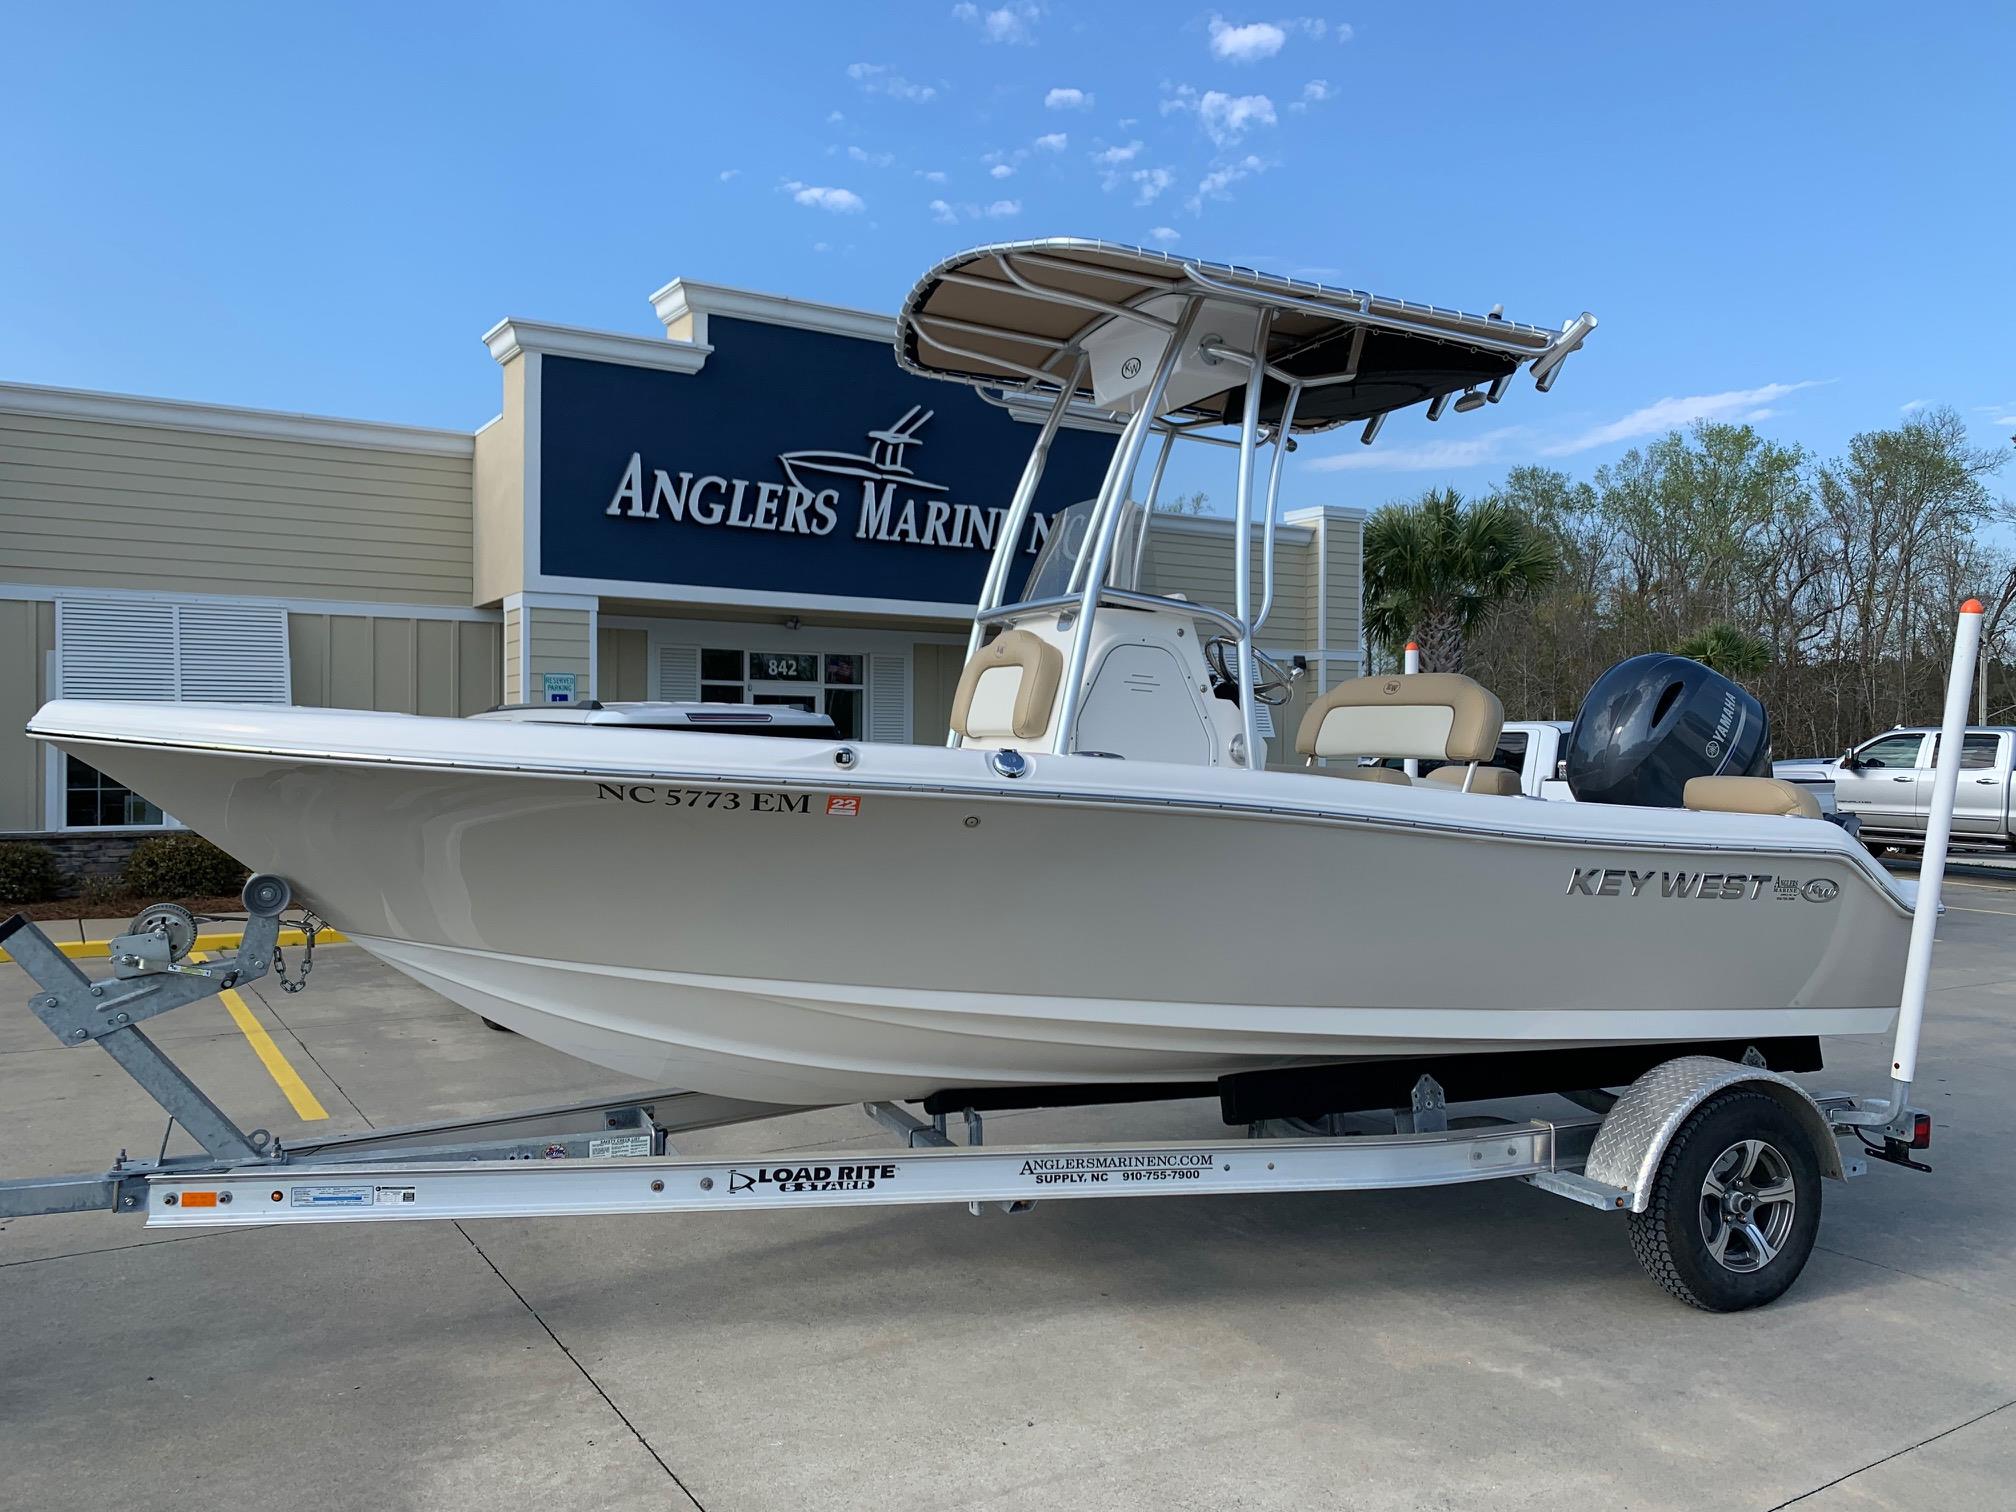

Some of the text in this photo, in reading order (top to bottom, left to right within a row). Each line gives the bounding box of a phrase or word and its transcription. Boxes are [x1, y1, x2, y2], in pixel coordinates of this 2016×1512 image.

[606, 452, 839, 536] ANGLERS
[768, 659, 798, 677] 842
[545, 677, 574, 685] RESERVED
[547, 684, 572, 692] PARKING
[1712, 691, 1736, 743] YAMAHA
[595, 783, 813, 814] NC 5773 EM
[831, 798, 857, 809] 22
[1566, 867, 1773, 901] KEY WEST
[758, 1164, 896, 1183] LOAD RITE
[1019, 1155, 1213, 1175] ANGLERSMARINENC.COM
[802, 1180, 871, 1192] STARR
[1035, 1170, 1200, 1184] SUPPLY, NC 910-755-7900
